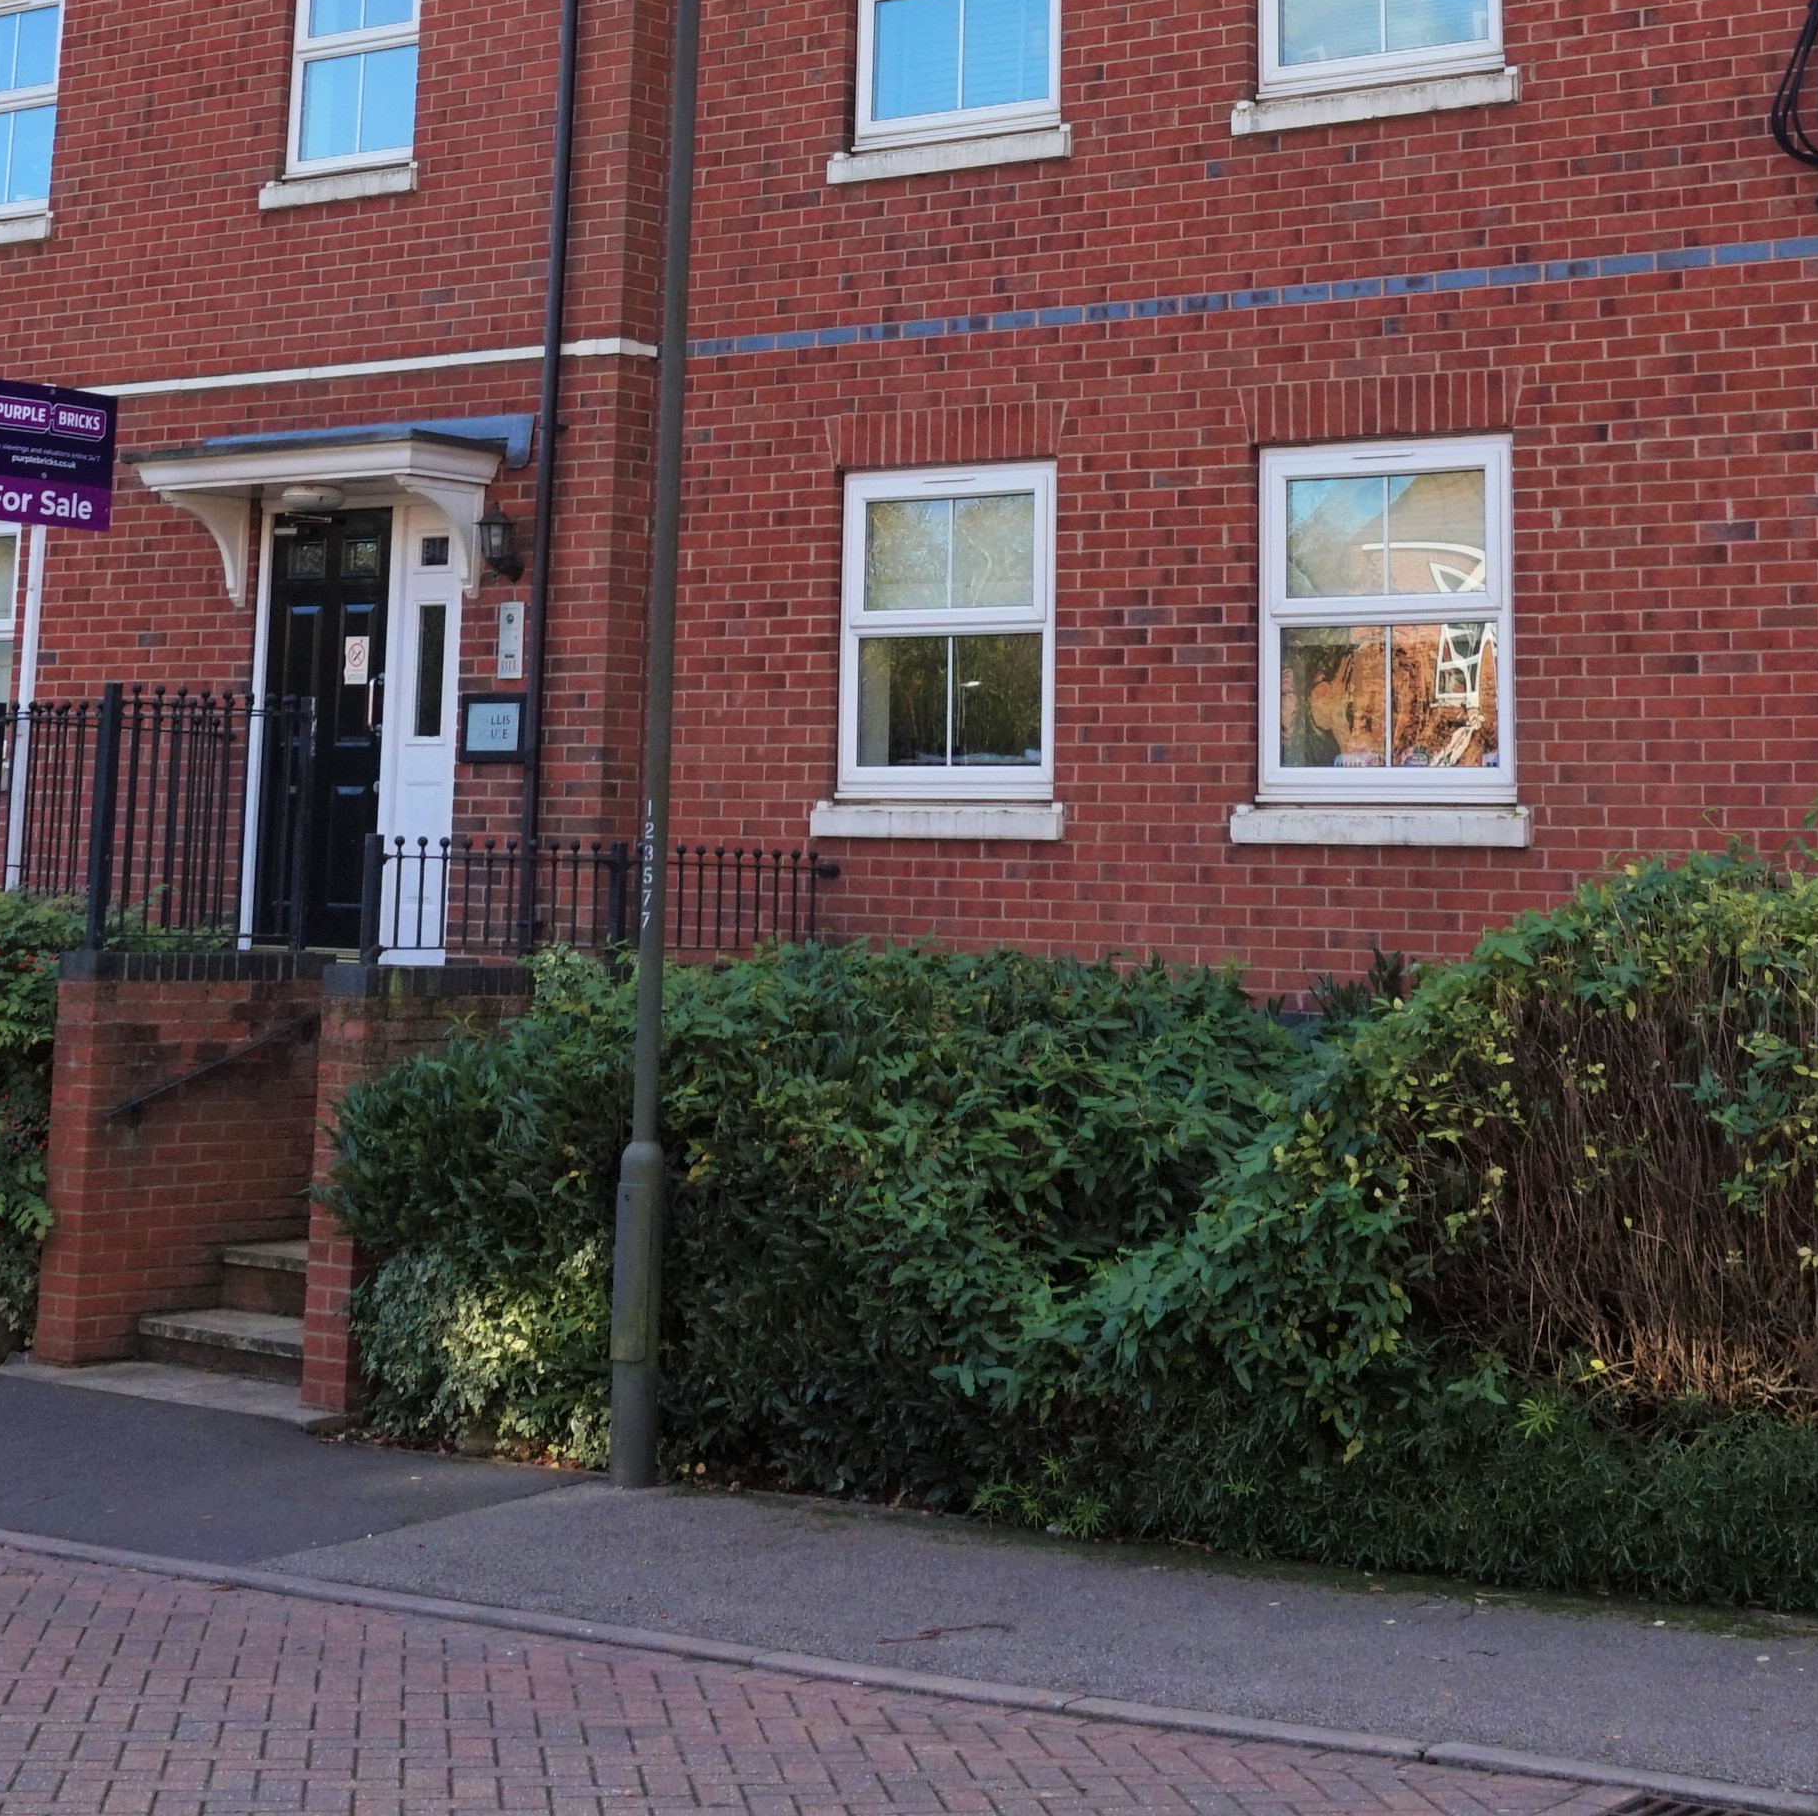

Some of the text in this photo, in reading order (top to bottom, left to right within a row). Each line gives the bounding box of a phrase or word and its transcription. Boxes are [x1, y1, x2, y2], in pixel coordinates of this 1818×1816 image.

[58, 410, 101, 431] BRICKS
[11, 454, 77, 469] purplebricks.co.uk
[39, 490, 93, 520] Sale
[641, 799, 655, 930] 123577
